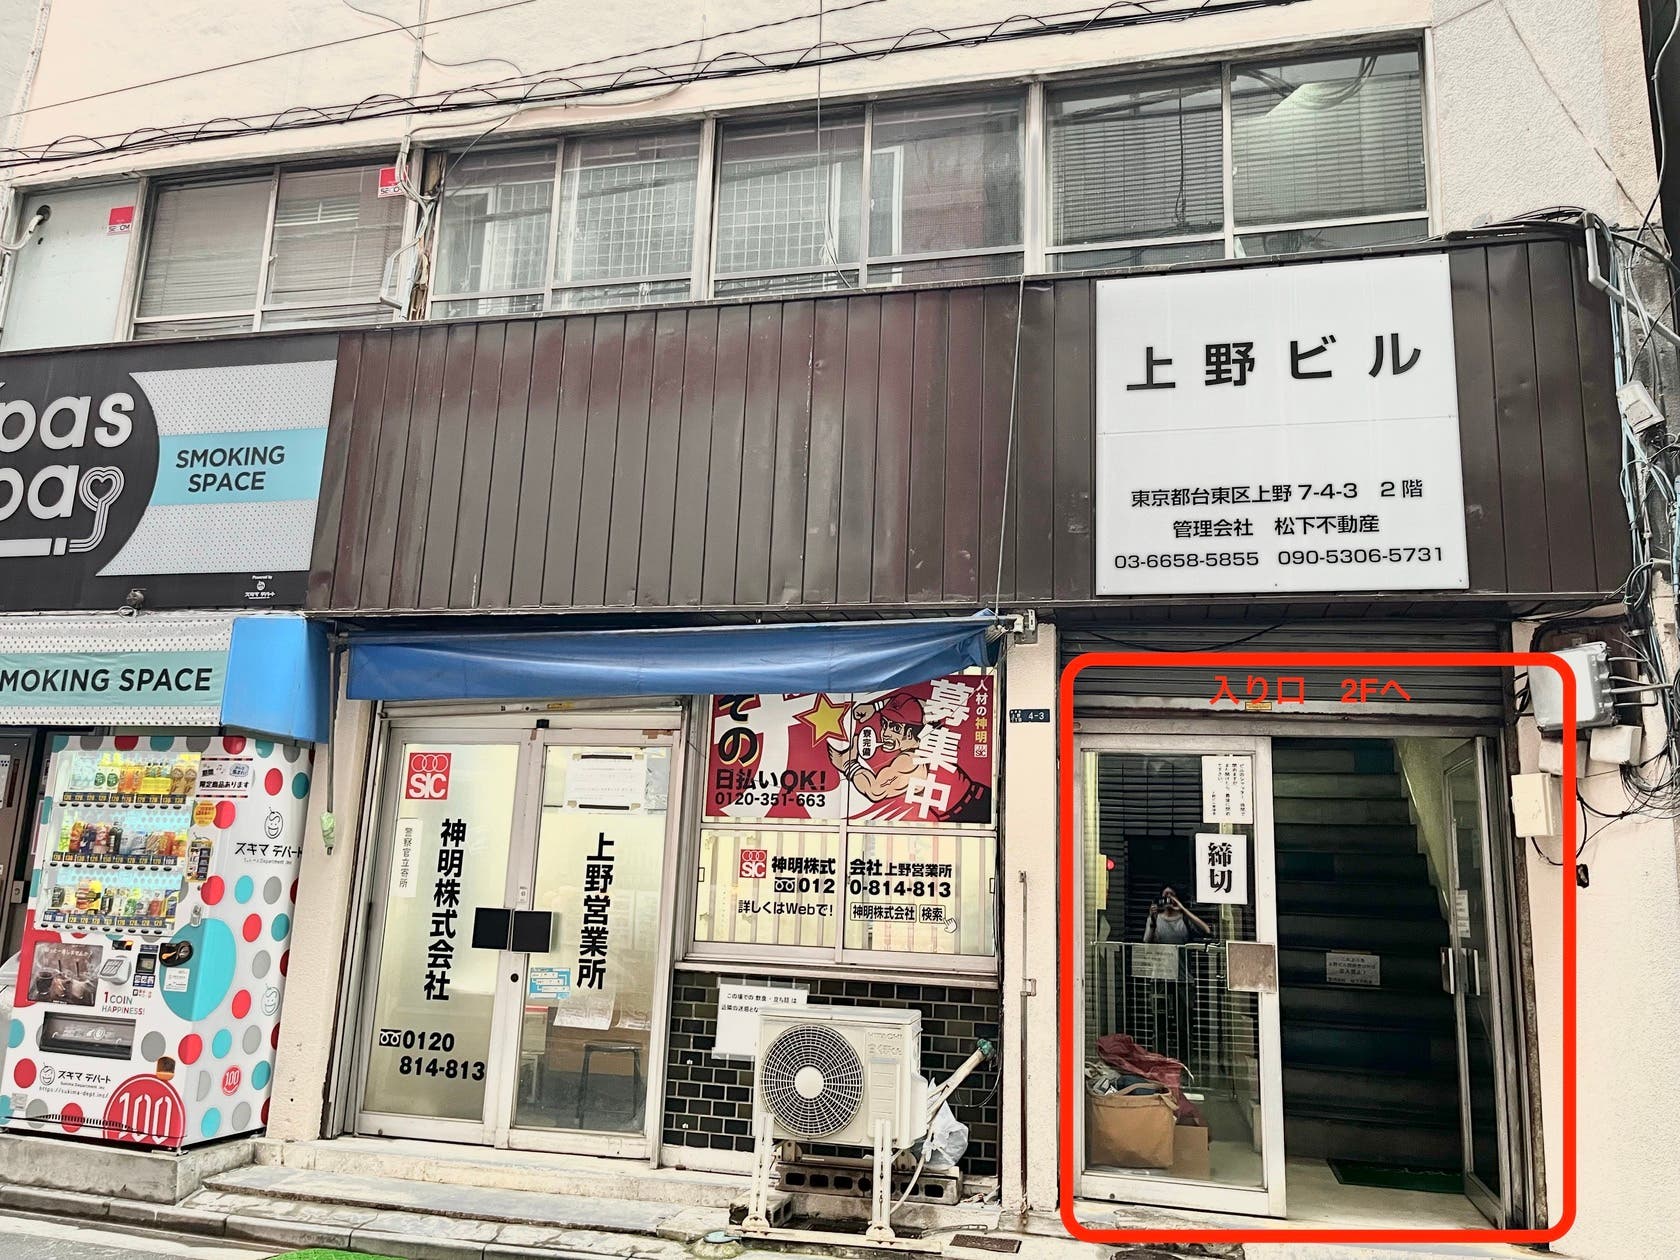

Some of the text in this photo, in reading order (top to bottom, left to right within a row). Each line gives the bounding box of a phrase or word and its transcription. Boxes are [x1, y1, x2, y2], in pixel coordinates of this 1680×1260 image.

[1126, 332, 1422, 392] 上野ビル
[176, 445, 285, 469] SMOKING
[187, 471, 266, 493] SPACE
[1381, 479, 1424, 499] 2階
[1173, 514, 1380, 539] 管理会社 松下不動産
[1114, 546, 1443, 570] 03-6658-5855 090-5306-5731
[118, 667, 213, 692] SPACE
[974, 678, 988, 744] 人材の神明
[1028, 711, 1045, 720] 4-3
[862, 728, 873, 757] 寮完備
[904, 679, 975, 820] 募集中
[409, 773, 448, 799] SIC
[716, 792, 826, 808] 0120-351-663
[235, 842, 268, 857] スキマ
[399, 827, 413, 889] 警察官立寄所
[741, 862, 766, 878] SIC
[885, 863, 952, 879] 上野営業所
[1207, 842, 1234, 895] 締切
[424, 818, 467, 1001] 神明株式会社
[576, 832, 615, 990] 上野営業所
[738, 900, 834, 917] 詳しくはWebで!
[852, 905, 944, 921] 神明株式会社 検索
[402, 1031, 455, 1053] 0120
[58, 1070, 111, 1084] スキマ デパート
[224, 1069, 240, 1086] 100
[399, 1056, 485, 1081] 814-813
[118, 1092, 173, 1144] 100
